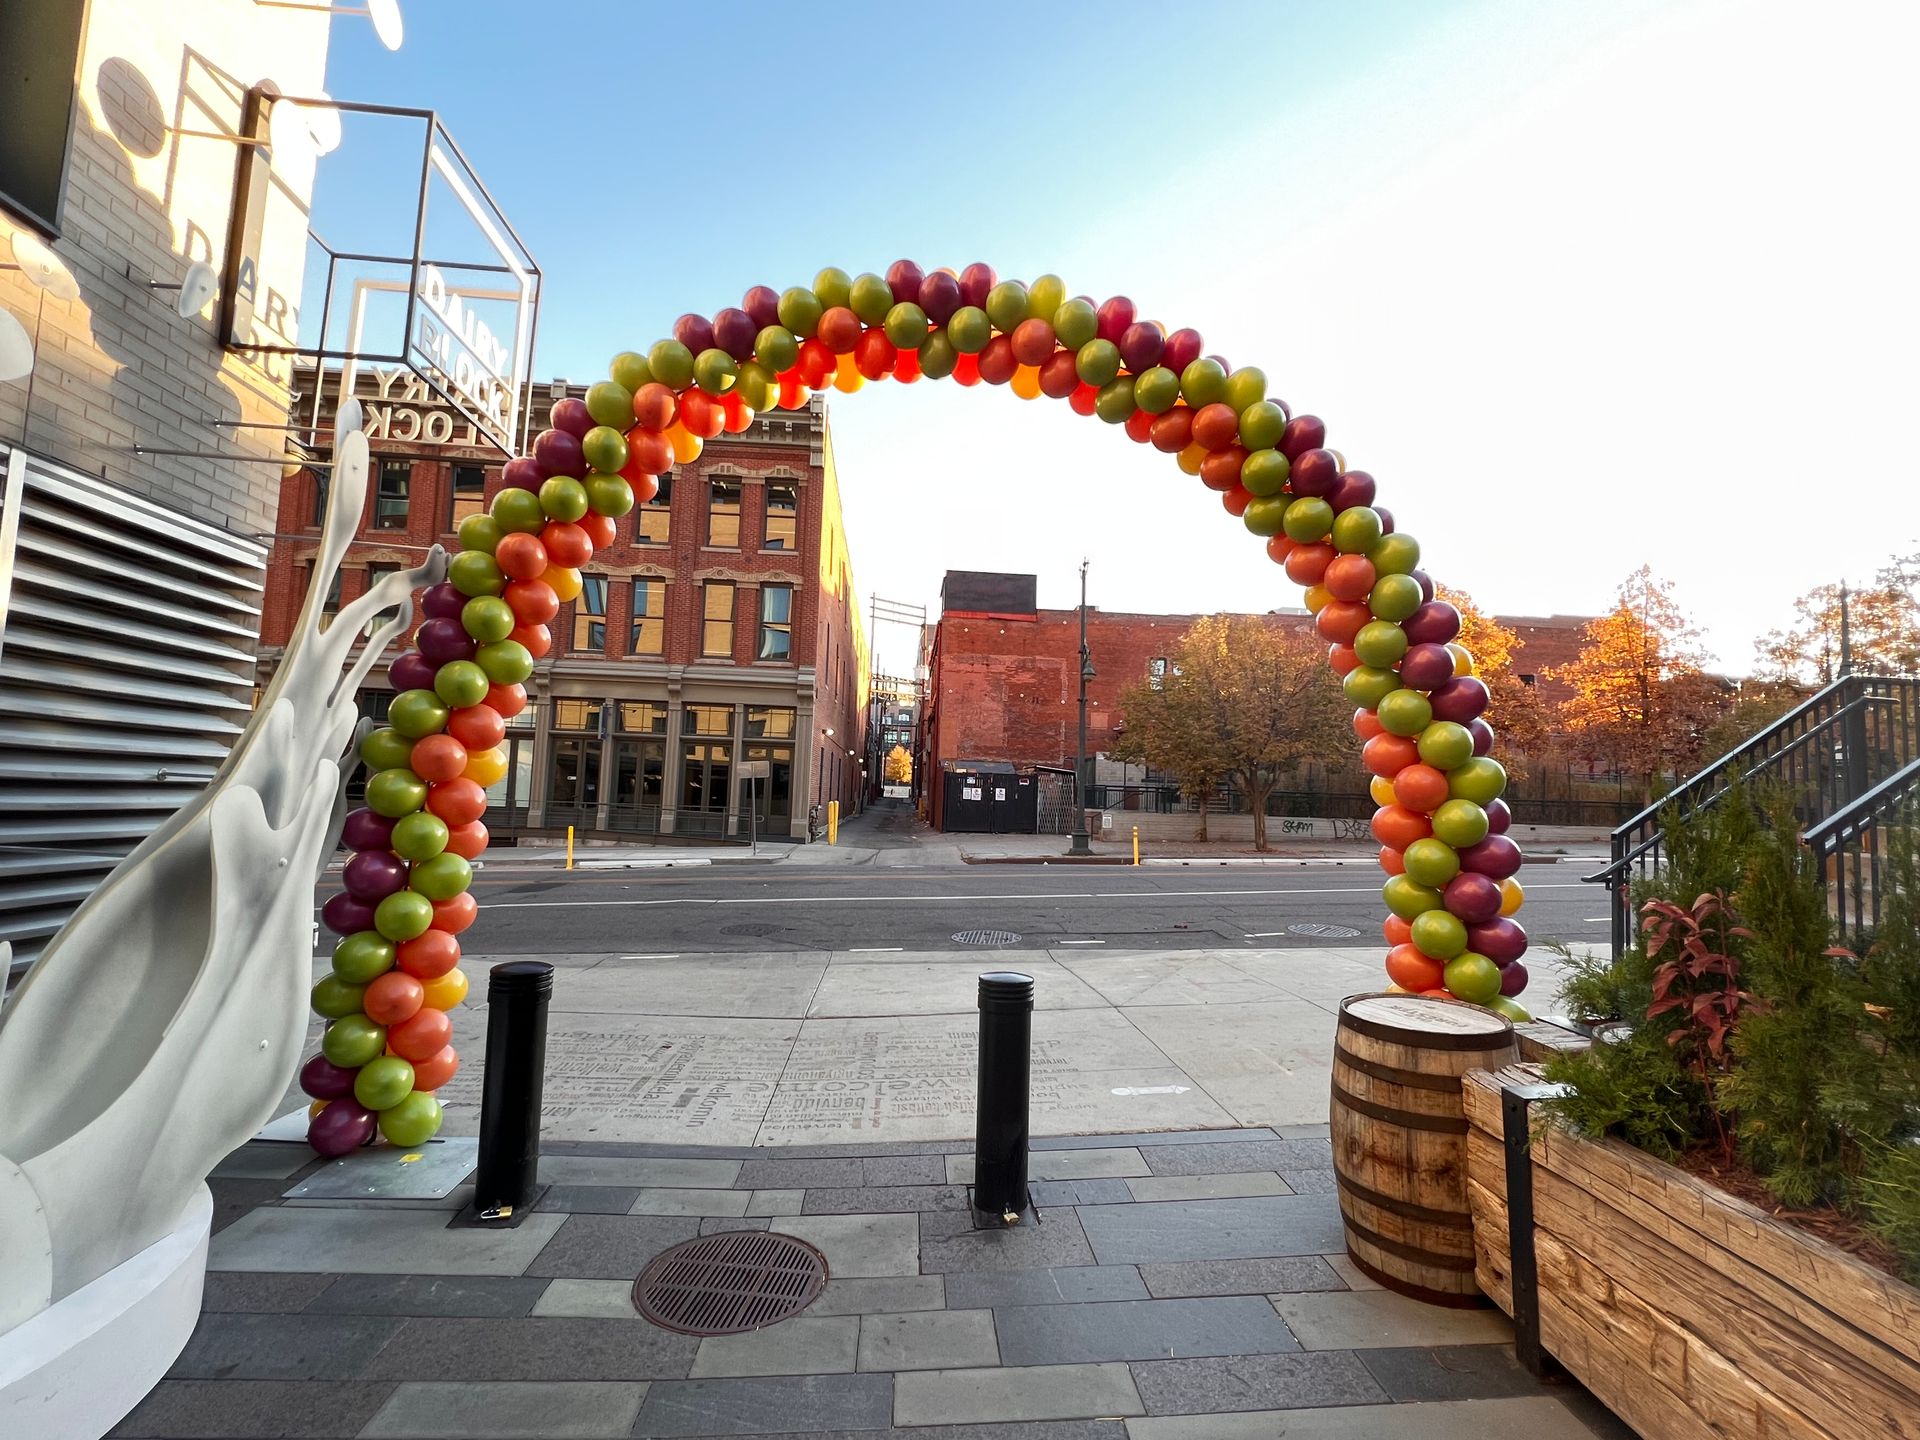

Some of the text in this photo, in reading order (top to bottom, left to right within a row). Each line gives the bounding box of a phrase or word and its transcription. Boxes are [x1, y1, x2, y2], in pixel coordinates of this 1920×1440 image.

[424, 264, 508, 378] DAIRY
[419, 313, 504, 426] BLOCK
[685, 1082, 734, 1128] velkomin
[745, 1078, 953, 1096] welcome
